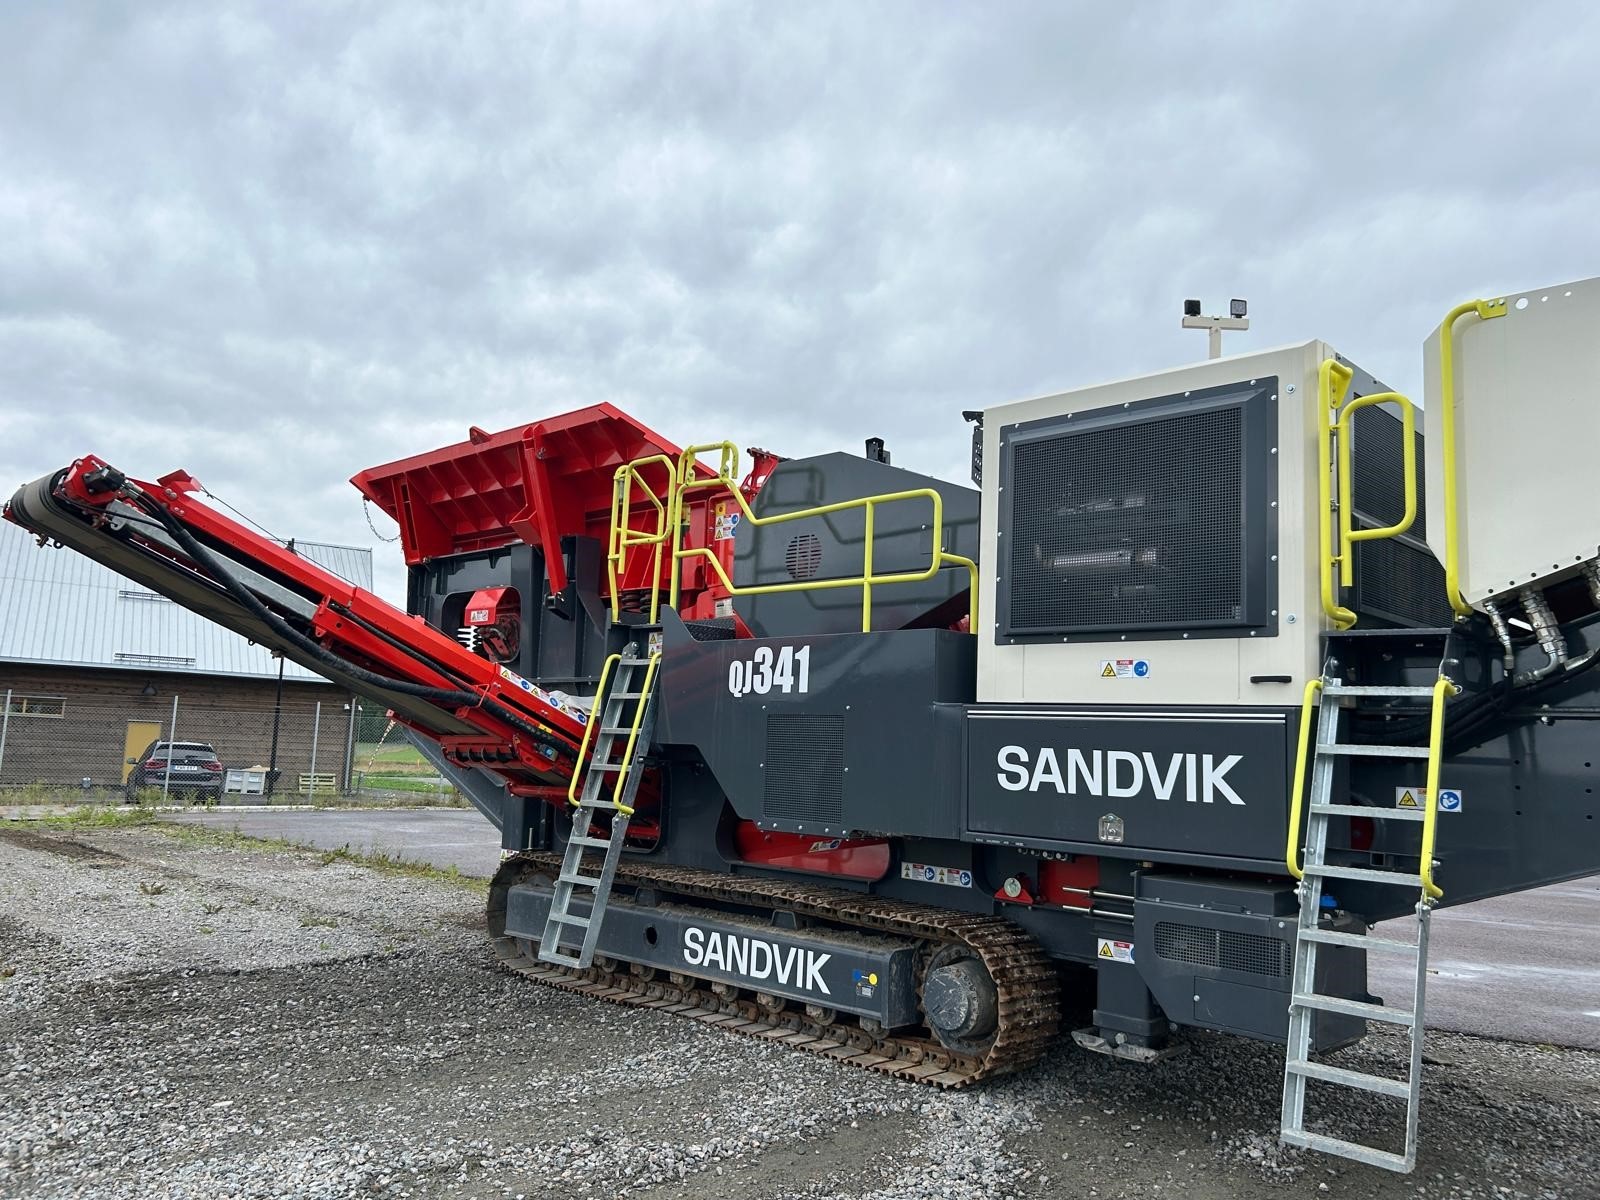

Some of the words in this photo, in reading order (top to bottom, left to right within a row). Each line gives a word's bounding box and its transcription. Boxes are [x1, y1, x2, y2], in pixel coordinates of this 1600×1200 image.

[728, 645, 810, 698] QJ341
[997, 745, 1246, 806] SANDVIK
[683, 927, 832, 995] SANDVIK
